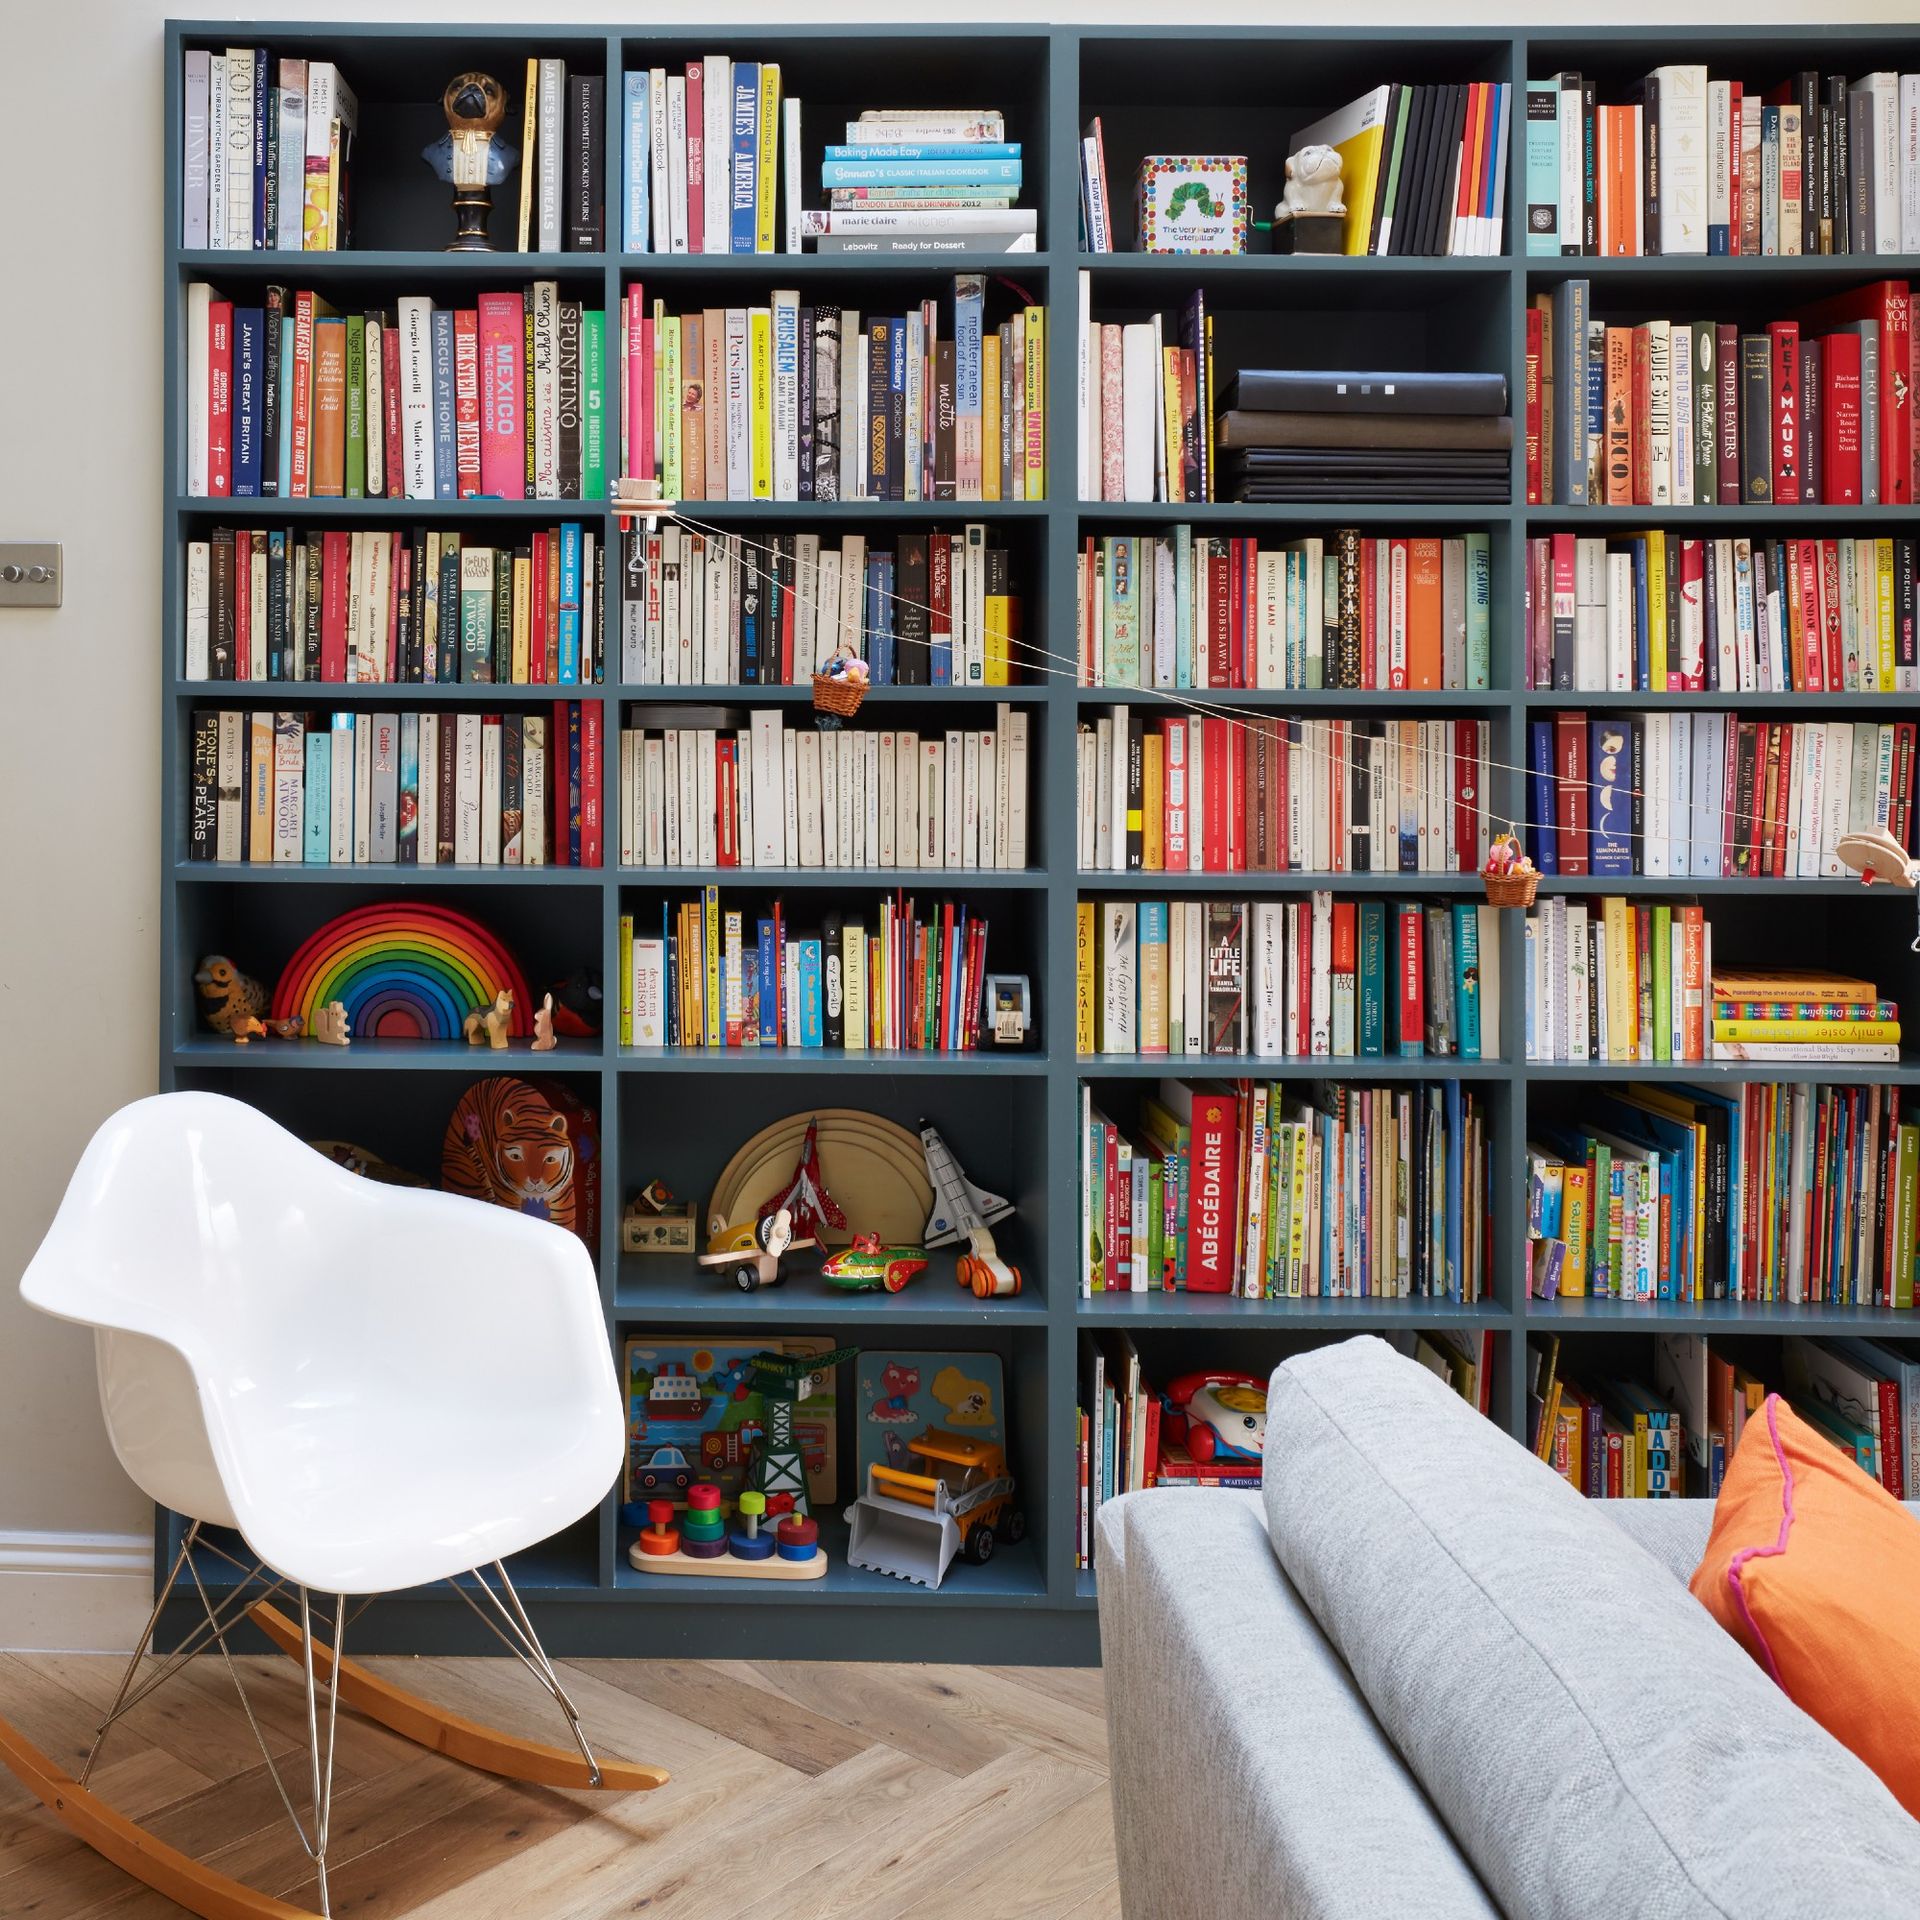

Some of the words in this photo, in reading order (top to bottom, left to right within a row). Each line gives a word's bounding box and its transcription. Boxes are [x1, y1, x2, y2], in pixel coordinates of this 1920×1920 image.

[229, 59, 250, 150] POLPO
[257, 90, 262, 98] IN
[544, 63, 555, 114] JAMIE'S
[736, 85, 754, 135] JAMIE'S
[544, 116, 555, 183] 30-MINUTE
[835, 147, 867, 159] Baking
[870, 148, 897, 156] Made
[900, 148, 922, 158] Easy
[1838, 148, 1846, 177] Memory
[735, 152, 754, 209] AMERICA
[1746, 155, 1754, 181] LAST
[544, 186, 554, 230] MEALS
[1091, 178, 1101, 212] HEAVEN
[1746, 189, 1754, 232] UTOPIA
[842, 217, 869, 225] marie
[871, 217, 896, 225] claire
[1094, 216, 1104, 251] TOASTIE
[843, 243, 878, 251] Lebovitz
[892, 242, 917, 250] Ready
[934, 241, 965, 249] Dessert
[243, 323, 252, 369] JAMIE'S
[296, 300, 310, 363] BREAKFAST
[349, 328, 360, 351] Nigel
[438, 316, 449, 374] MARCUS
[630, 324, 640, 356] THAI
[778, 305, 795, 372] JERUSALEM
[895, 328, 903, 357] Nordic
[958, 326, 966, 347] food
[351, 357, 360, 386] Slater
[560, 308, 576, 428] SPUNTINO
[729, 334, 744, 398] Persiana
[969, 316, 979, 406] mediterranean
[1651, 335, 1669, 381] ZADIE
[1676, 336, 1688, 375] GETTING
[778, 376, 786, 397] SAMI
[893, 358, 902, 390] Bakery
[958, 364, 966, 380] the
[1676, 380, 1688, 391] TO
[1724, 361, 1736, 407] SPIDER
[242, 373, 251, 412] GREAT
[350, 388, 360, 410] Real
[439, 380, 449, 397] AT
[497, 345, 514, 434] MEXICO
[787, 376, 795, 404] YOTAM
[440, 402, 450, 443] HOME
[894, 394, 903, 438] Cookbook
[940, 384, 955, 430] miette
[1652, 390, 1669, 436] SMITH
[1677, 396, 1689, 424] 50/50
[242, 416, 251, 464] BRITAIN
[296, 426, 305, 446] FERN
[350, 414, 360, 438] Food
[1028, 411, 1041, 468] CABANA
[1724, 412, 1736, 458] EATERS
[295, 449, 304, 475] GREEN
[1611, 431, 1629, 478] ECO
[309, 545, 318, 569] Alice
[1476, 550, 1488, 569] LIFE
[1802, 546, 1811, 563] NOT
[309, 571, 318, 603] Munro
[1218, 565, 1226, 593] ERIC
[1267, 560, 1275, 600] INVISIBLE
[1476, 571, 1488, 605] SAVING
[1803, 565, 1812, 590] THAT
[1827, 553, 1837, 608] POWER
[500, 572, 510, 628] MACBETH
[1267, 605, 1275, 626] MAN
[1804, 592, 1813, 616] KIND
[309, 606, 318, 630] Dear
[465, 596, 475, 652] ATWOOD
[476, 596, 486, 652] MARGARET
[1806, 618, 1814, 630] OF
[308, 633, 317, 652] Life
[1218, 600, 1226, 670] HOBSBAWM
[1807, 632, 1816, 654] GIRL
[1904, 635, 1912, 660] PLEASE
[196, 731, 205, 765] FALL
[207, 719, 217, 777] STONE'S
[1882, 734, 1890, 751] STAY
[1881, 754, 1890, 772] WITH
[1880, 775, 1889, 785] ME
[195, 786, 205, 840] PEARS
[207, 800, 215, 826] IAIN
[279, 779, 289, 839] ATWOOD
[290, 779, 298, 839] MARGARET
[1209, 948, 1241, 959] LITTLE
[1209, 960, 1241, 976] LIFE
[1687, 924, 1700, 986] Bumpology
[638, 968, 647, 1017] maison
[649, 968, 658, 1000] devant
[649, 1003, 656, 1016] ma
[1800, 1009, 1842, 1017] Discipline
[1846, 1010, 1892, 1018] No-Drama
[1816, 1028, 1846, 1036] oster
[1850, 1026, 1883, 1036] emily
[1254, 1100, 1264, 1153] PLAYTOWN
[1198, 1132, 1221, 1270] ABÉCÉDAIRE
[1911, 1402, 1919, 1418] See
[1559, 1438, 1567, 1463] Nursery
[1888, 1427, 1896, 1452] Rhyme
[1911, 1421, 1919, 1449] Inside
[1890, 1456, 1898, 1485] Picture
[1911, 1453, 1920, 1496] London
